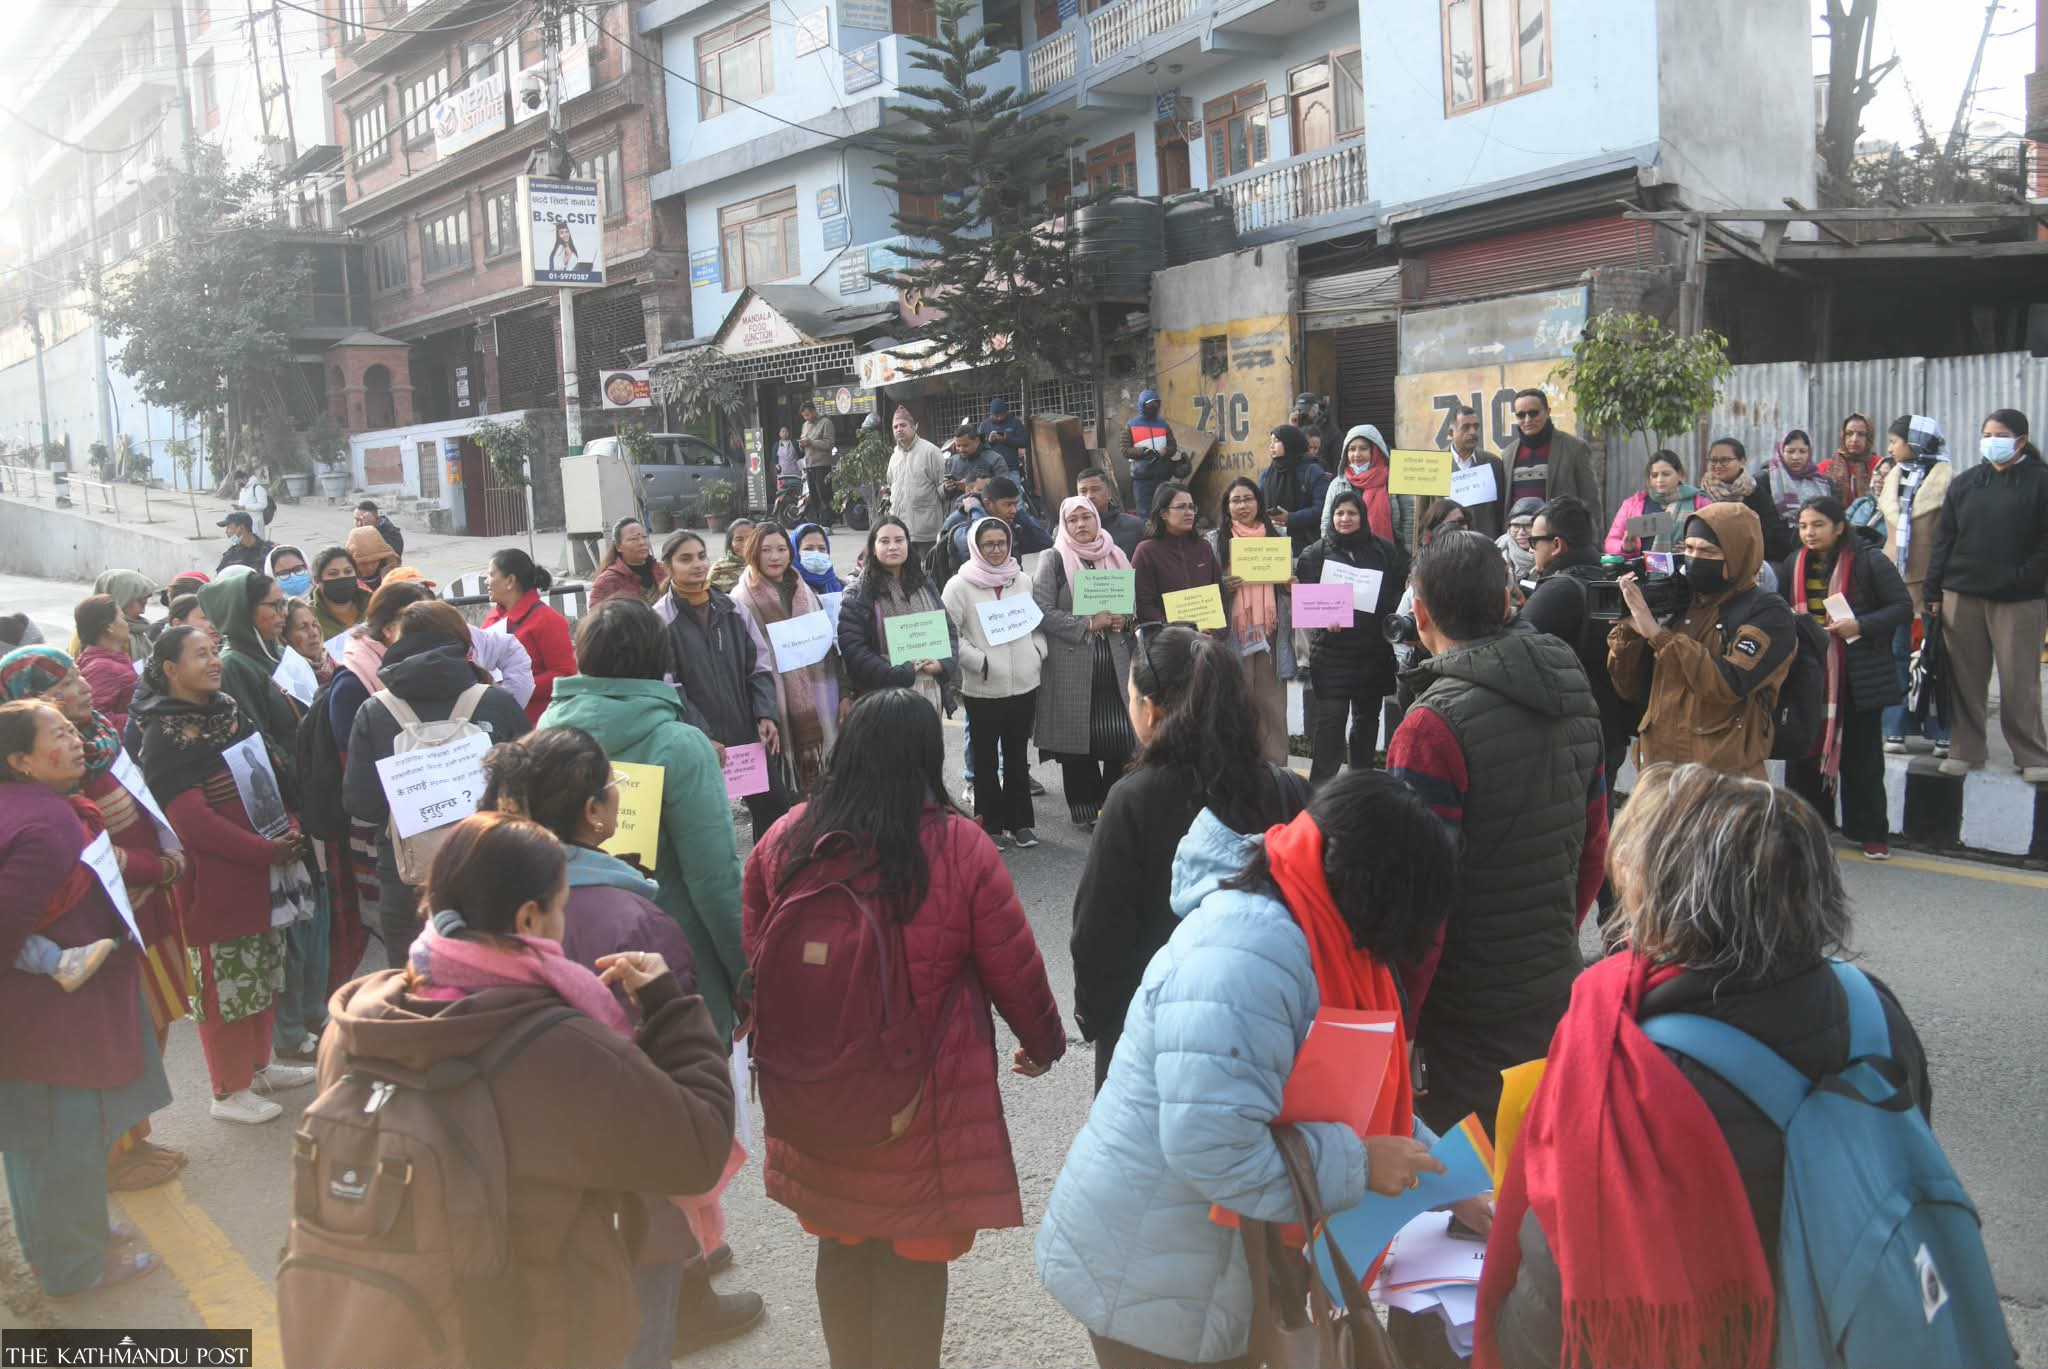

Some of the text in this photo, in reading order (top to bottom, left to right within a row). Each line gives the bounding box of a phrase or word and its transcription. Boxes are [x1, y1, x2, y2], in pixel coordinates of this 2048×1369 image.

[743, 312, 772, 325] MANDALA
[749, 323, 767, 334] FOOD
[744, 329, 773, 342] JUNCTION
[1193, 392, 1250, 442] ZIC
[622, 820, 636, 831] for
